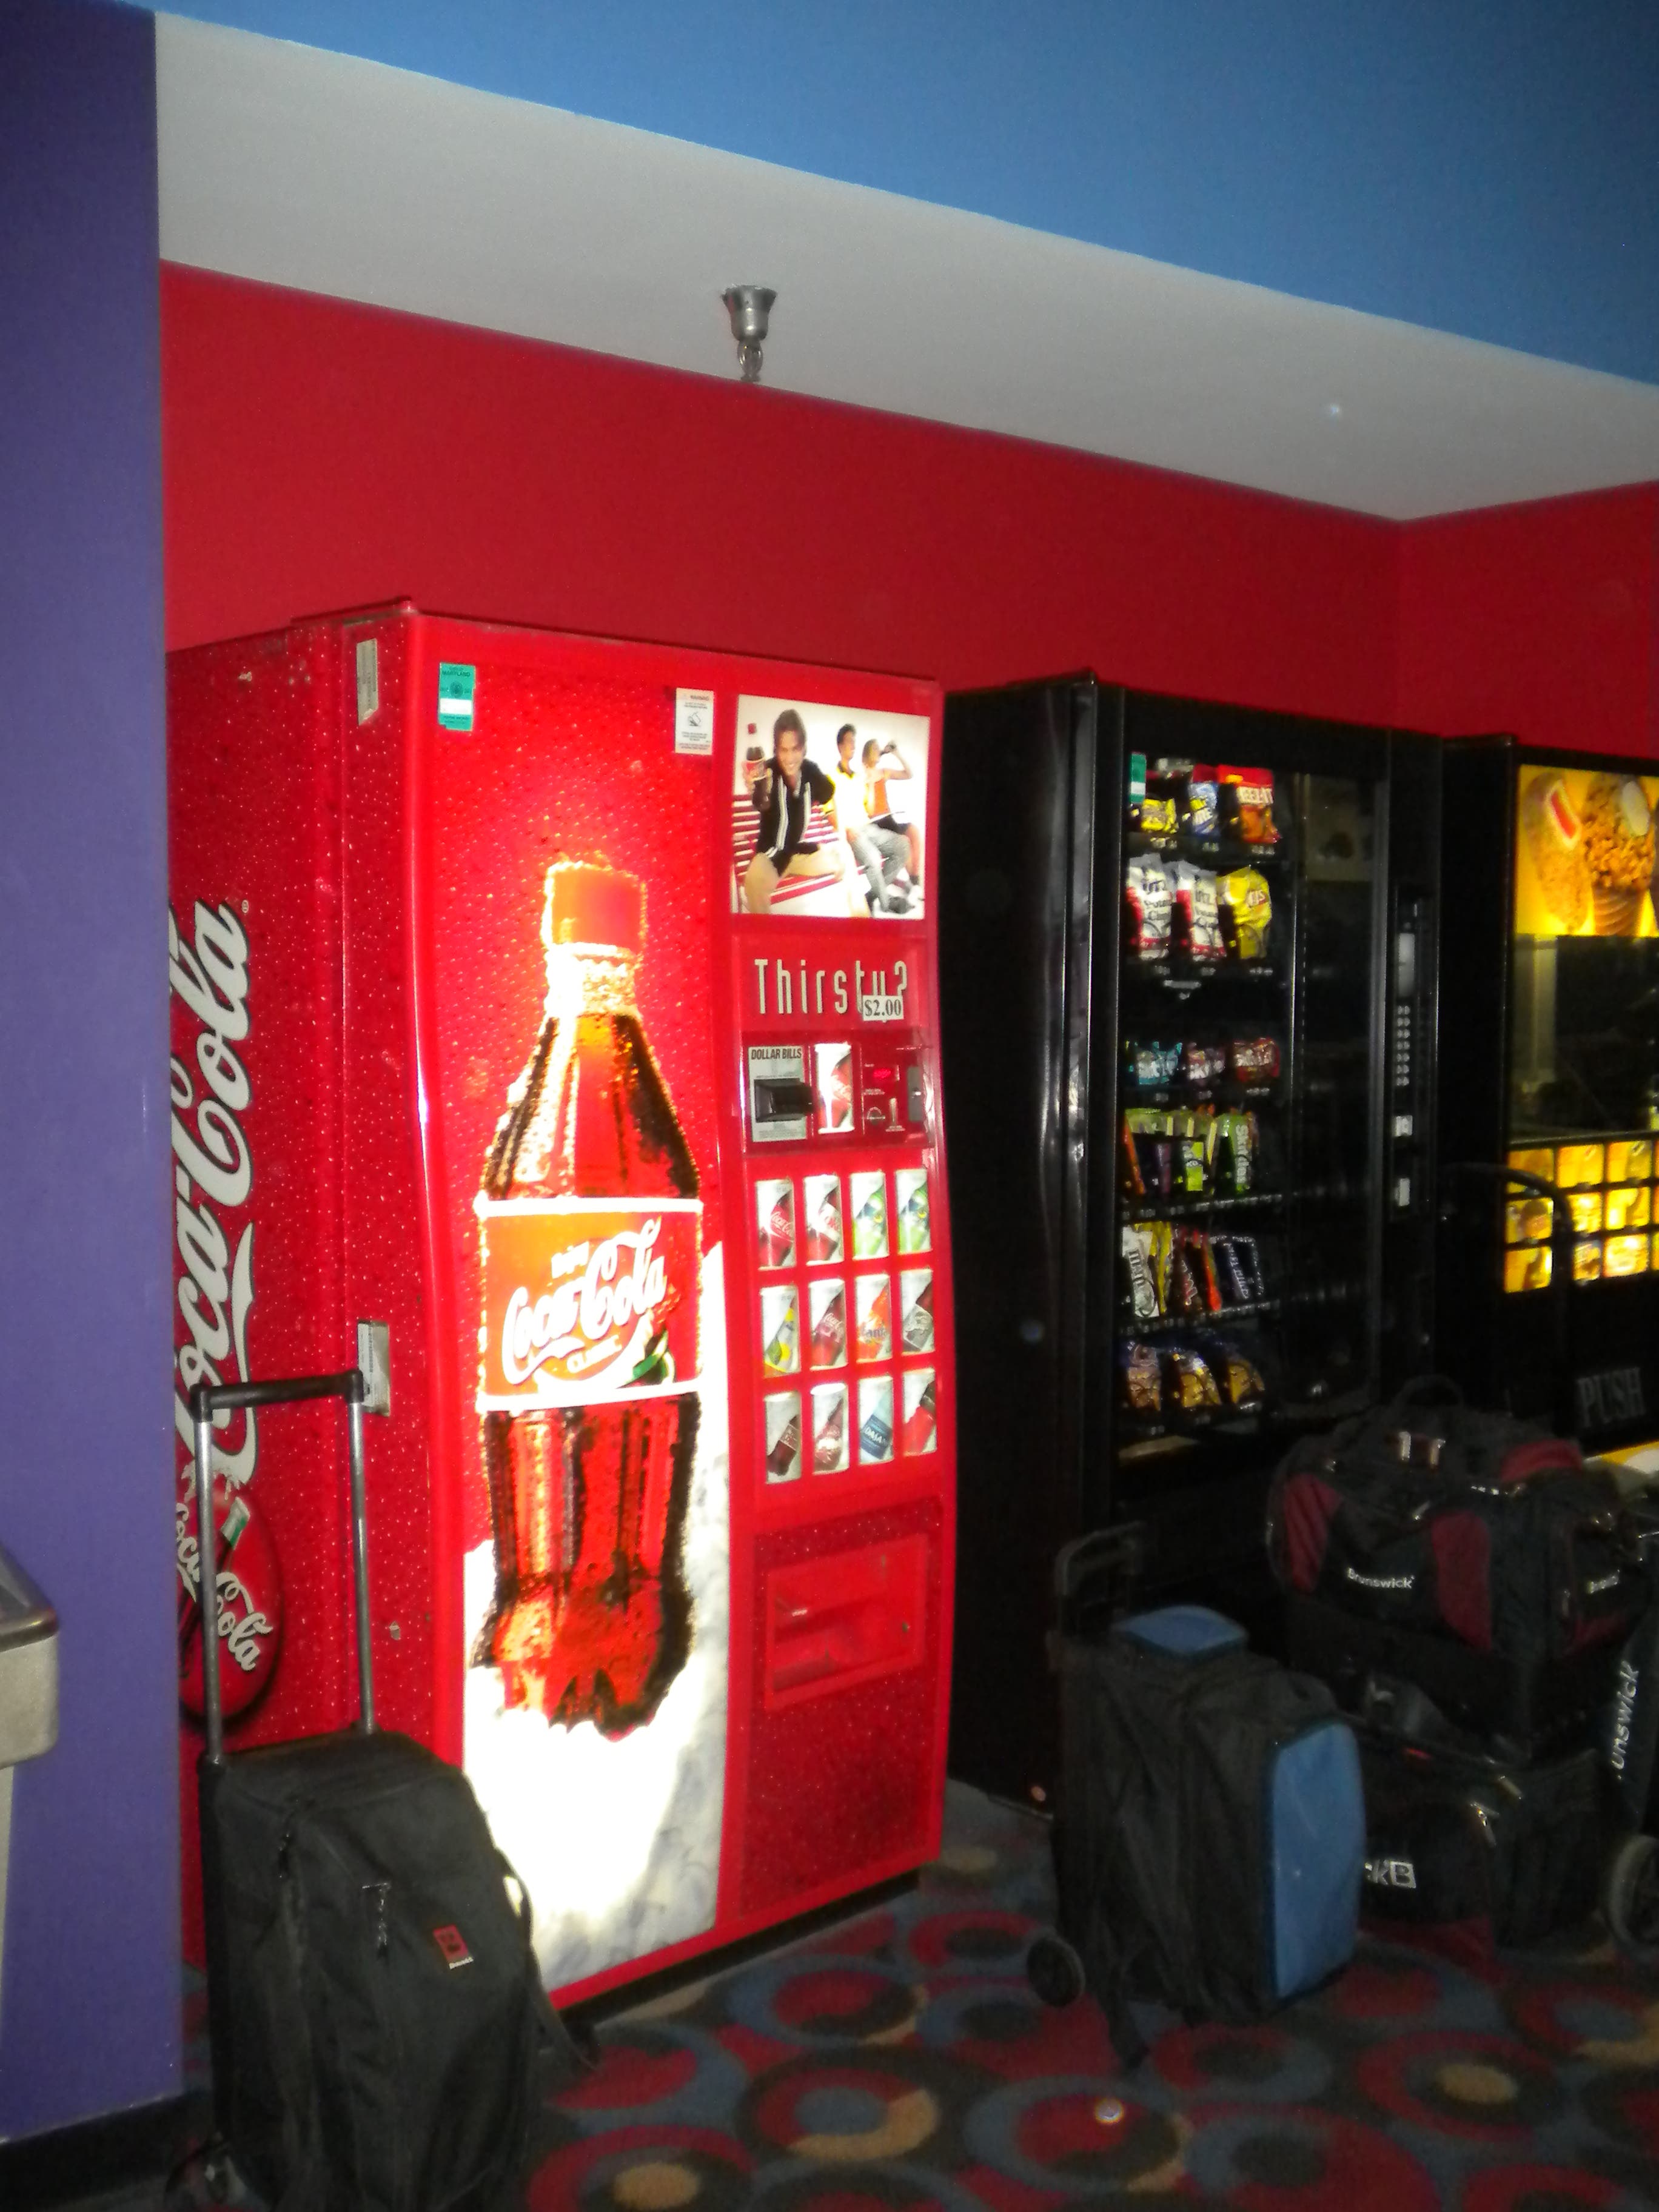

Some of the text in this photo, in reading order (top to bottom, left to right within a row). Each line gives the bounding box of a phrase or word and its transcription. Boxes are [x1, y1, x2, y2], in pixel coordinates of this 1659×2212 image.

[864, 999, 902, 1016] $2.00
[751, 1047, 802, 1060] DOLLAR BILLS
[501, 1215, 668, 1386] Coca-Cola
[1578, 1367, 1646, 1427] PUSH
[1346, 1567, 1415, 1589] Brunswick
[1611, 1660, 1639, 1771] unswick
